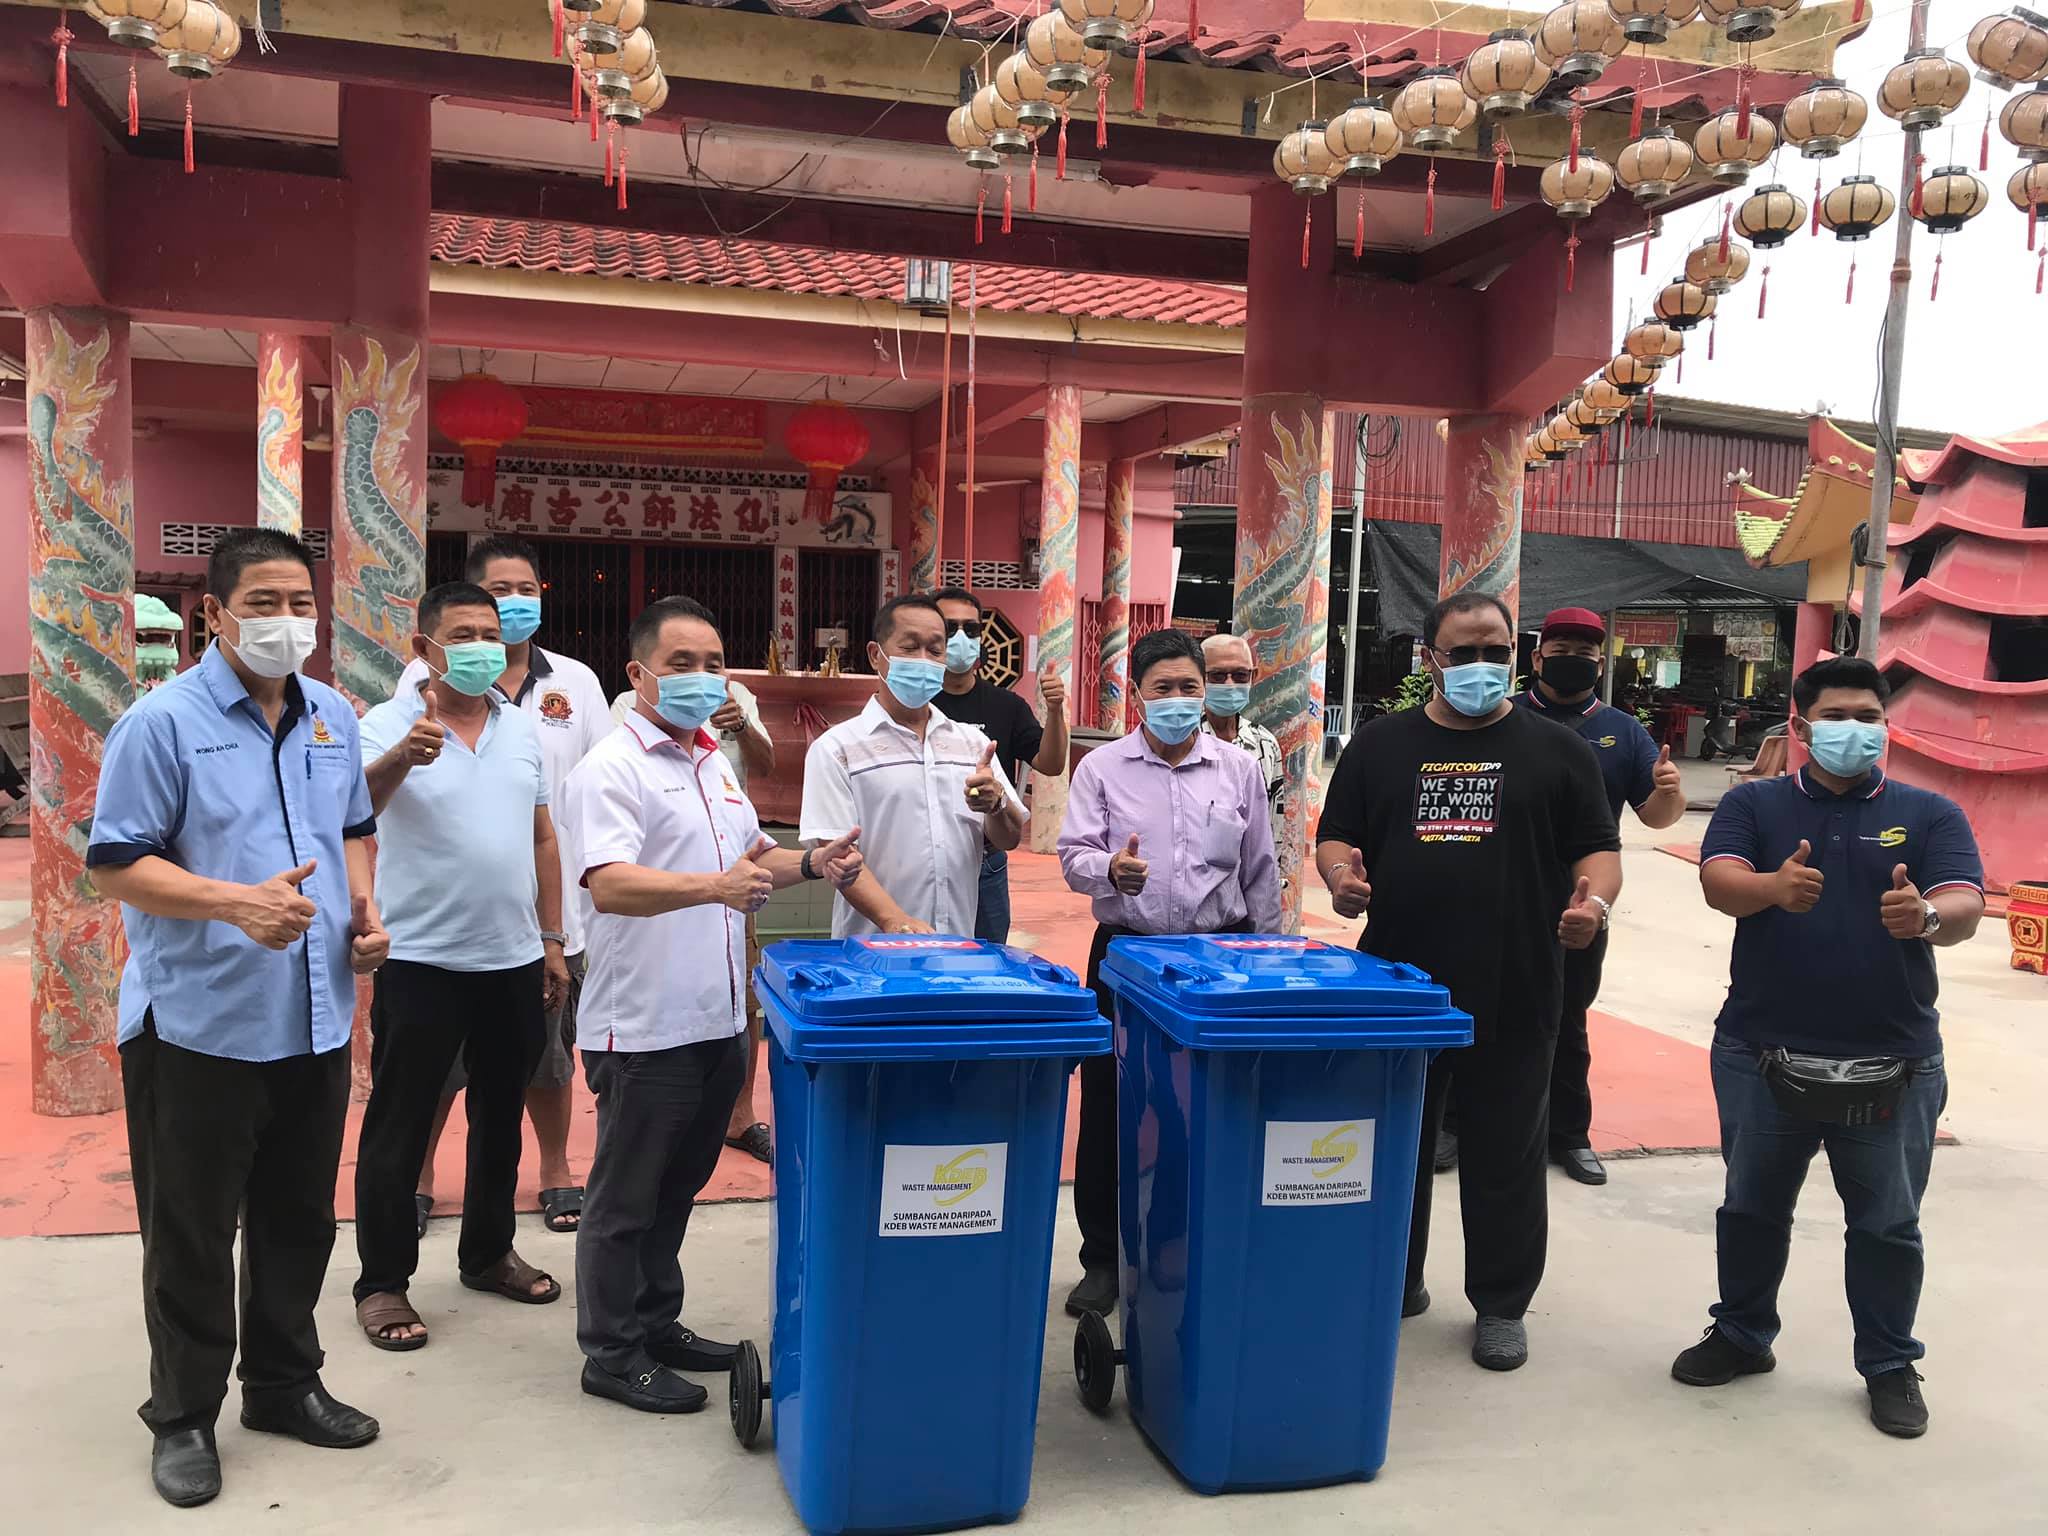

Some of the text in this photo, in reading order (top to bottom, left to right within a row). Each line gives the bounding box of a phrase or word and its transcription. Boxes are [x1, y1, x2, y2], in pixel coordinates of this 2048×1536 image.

[1421, 778, 1498, 791] WE STAY
[1419, 793, 1495, 806] AT WORK
[1417, 807, 1493, 820] FOR YOU
[902, 1183, 972, 1191] WASTE MANAGEMENT
[1274, 1181, 1362, 1192] SUMBANGAN DARIPADA
[1266, 1189, 1367, 1200] KDEB WASTE MANAGEMENT
[893, 1210, 992, 1221] SUMBANGAN DARIPADA
[884, 1219, 998, 1230] KDEB WASTE MANAGEMENT
